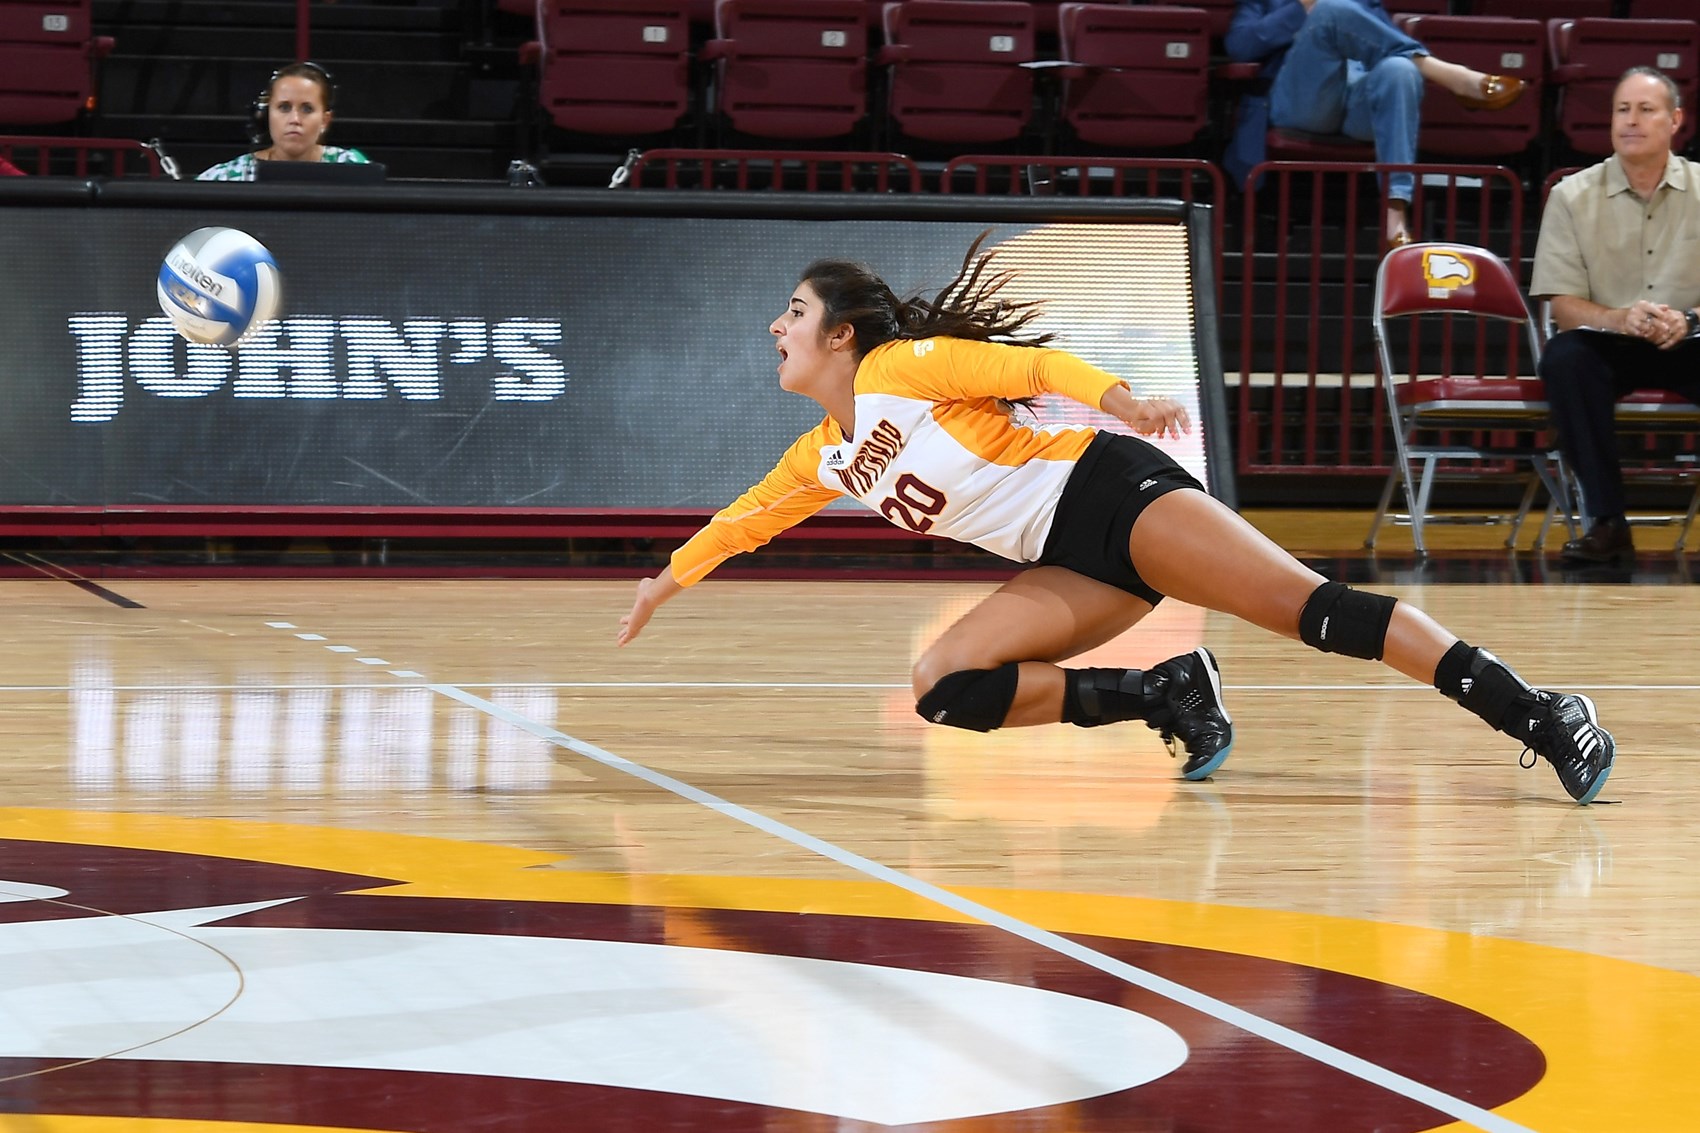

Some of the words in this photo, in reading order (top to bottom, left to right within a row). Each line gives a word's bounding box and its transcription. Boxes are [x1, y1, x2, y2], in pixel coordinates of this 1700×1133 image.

[171, 255, 223, 297] molten
[68, 312, 568, 423] JOHN'S
[880, 473, 947, 534] 20
